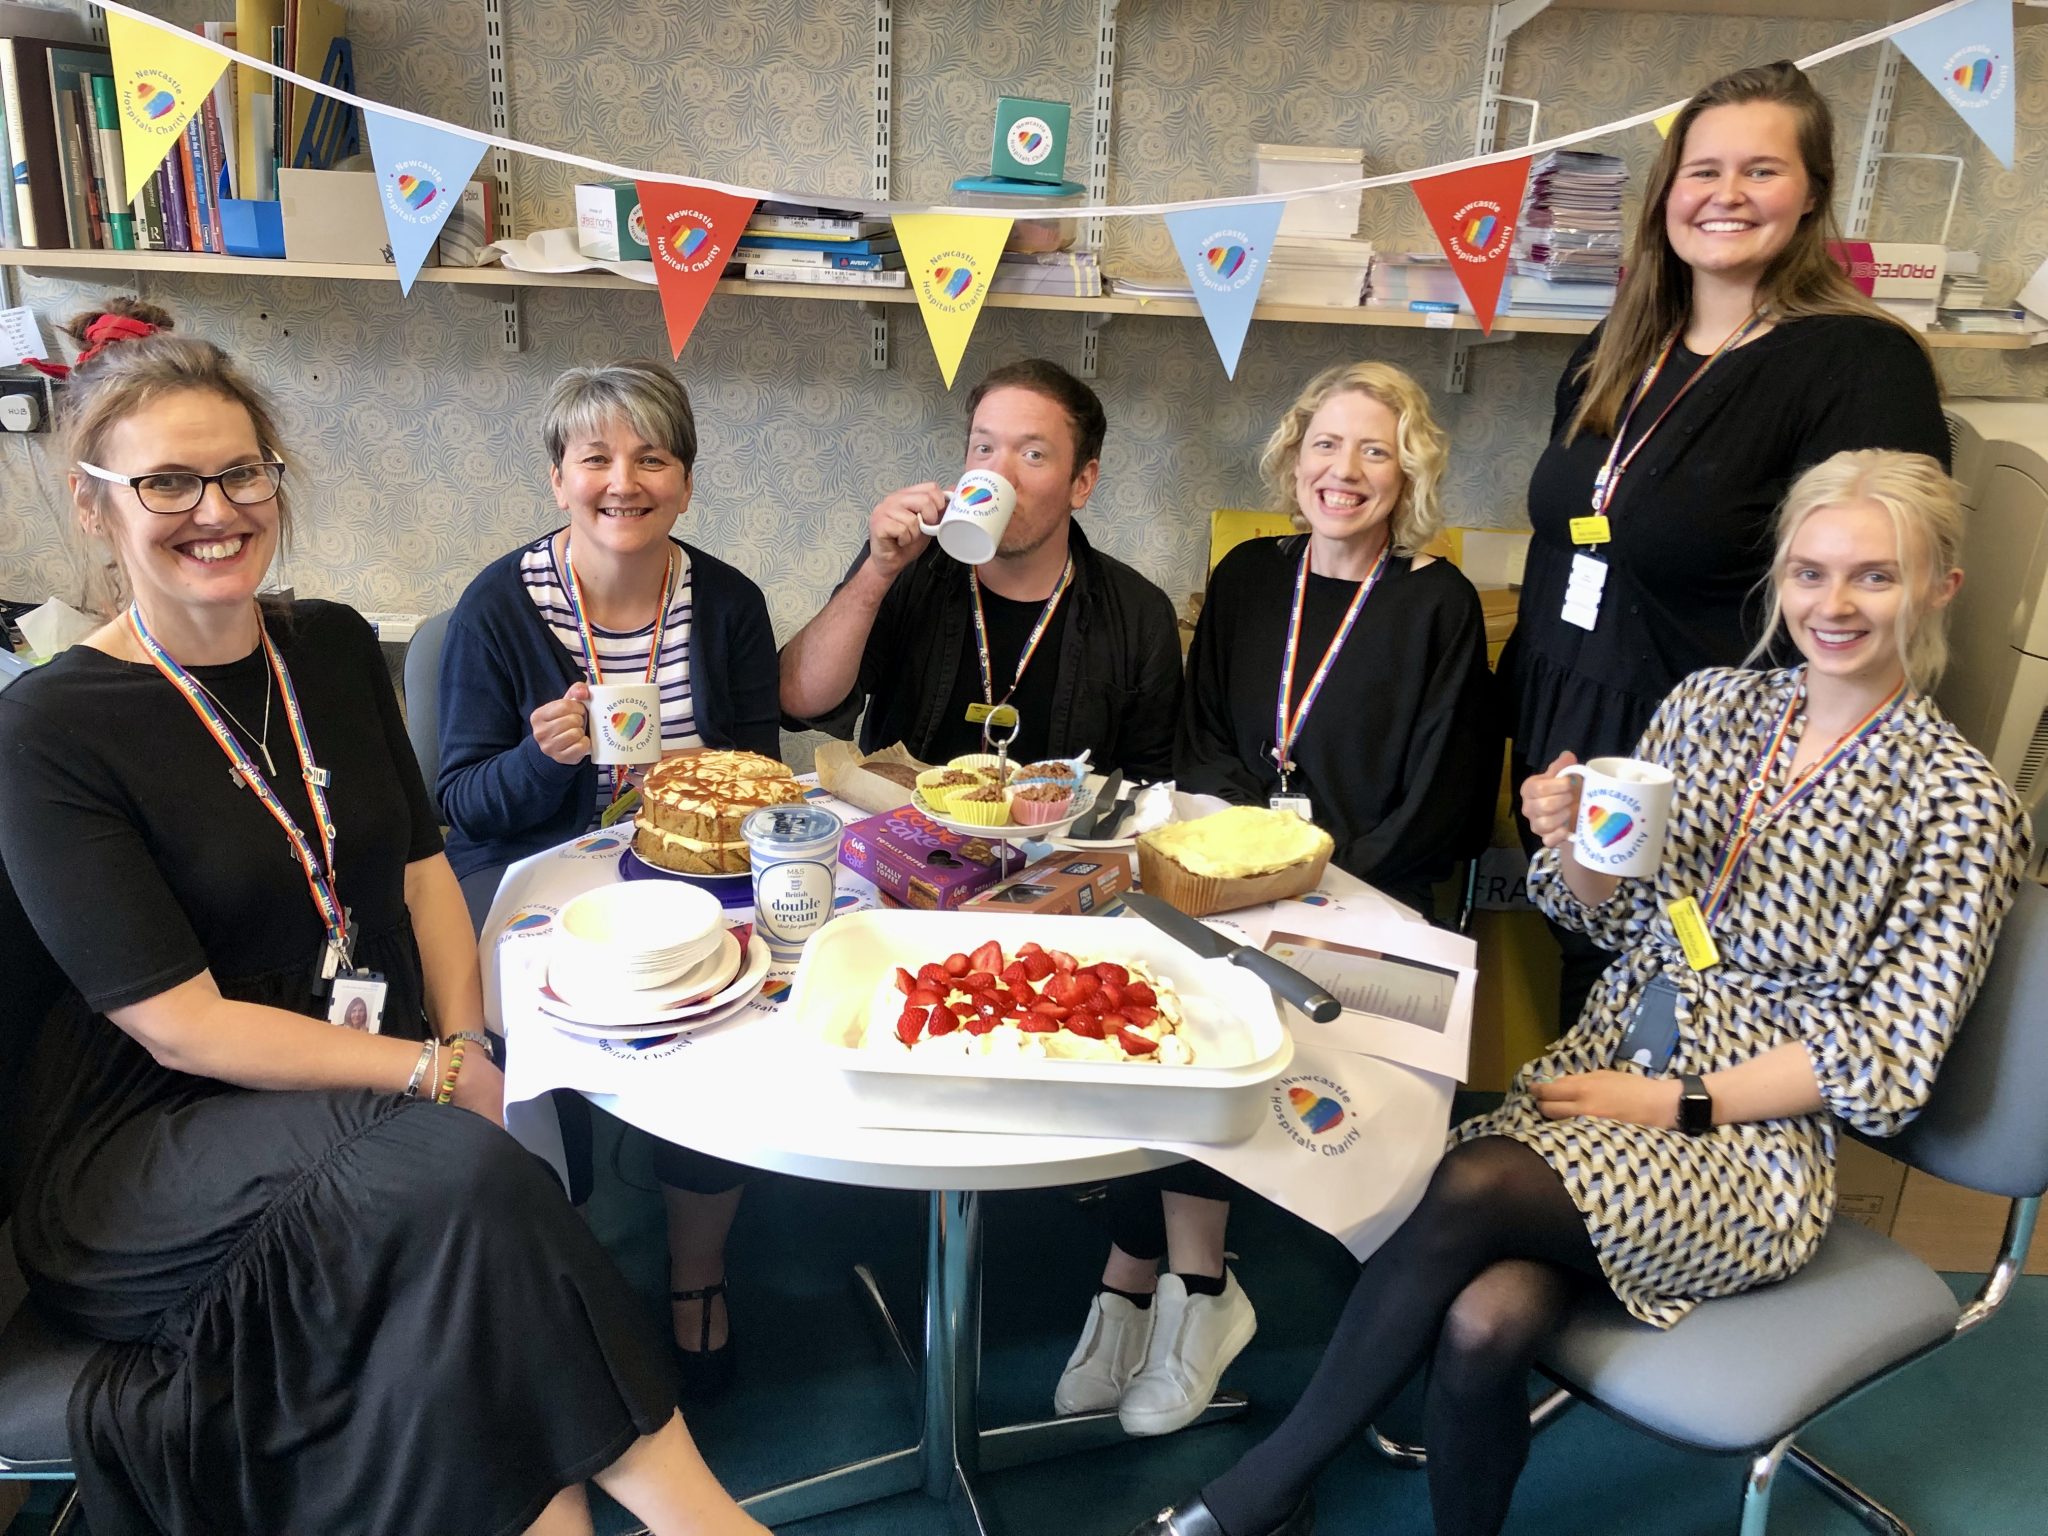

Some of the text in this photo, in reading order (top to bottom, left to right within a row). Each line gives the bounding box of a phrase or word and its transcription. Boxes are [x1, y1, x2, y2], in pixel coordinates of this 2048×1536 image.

[135, 68, 182, 95] Newcastle
[124, 91, 152, 133] Hospitals
[156, 113, 187, 135] Charity
[1016, 120, 1046, 133] Newcastle
[1010, 139, 1030, 162] Hospitals
[394, 160, 442, 183] Newcastle
[385, 184, 449, 224] Hospitals Charity
[1453, 200, 1501, 221] Newcastle
[666, 209, 713, 229] Newcastle
[1201, 229, 1249, 248] Newcastle
[1449, 225, 1513, 263] Hospitals Charity
[657, 236, 721, 272] Hospitals Charity
[849, 259, 870, 267] AVERY
[930, 250, 976, 267] Newcastle
[1196, 258, 1259, 292] Hospitals Charity
[923, 281, 985, 313] Hospitals Charity
[973, 505, 999, 517] Charity
[1047, 591, 1061, 610] NHS
[578, 622, 590, 638] NHS
[974, 610, 984, 630] NHS
[656, 628, 664, 645] NHS
[1029, 624, 1043, 643] NHS
[143, 635, 161, 657] NHS
[274, 653, 286, 673] NHS
[587, 658, 598, 674] NHS
[177, 675, 198, 696] NHS
[289, 700, 300, 721] NHS
[606, 698, 649, 712] Newcastle
[211, 718, 230, 740] NHS
[601, 723, 655, 753] Hospitals Charity
[315, 794, 326, 816] NHS
[1587, 788, 1642, 813] Newcastle
[275, 806, 292, 827] NHS
[851, 837, 866, 853] We
[875, 836, 927, 870] TOTALLY TOFFEE
[1609, 832, 1649, 864] Charity
[304, 849, 317, 870] NHS
[875, 859, 902, 880] TOTALLY
[876, 866, 900, 886] TOFFEE
[321, 895, 335, 916] NHS
[771, 898, 821, 912] double
[774, 911, 818, 923] cream
[598, 1038, 637, 1061] ospitals
[1280, 1074, 1351, 1104] Newcastle
[1270, 1096, 1362, 1157] Hospitals Charity
